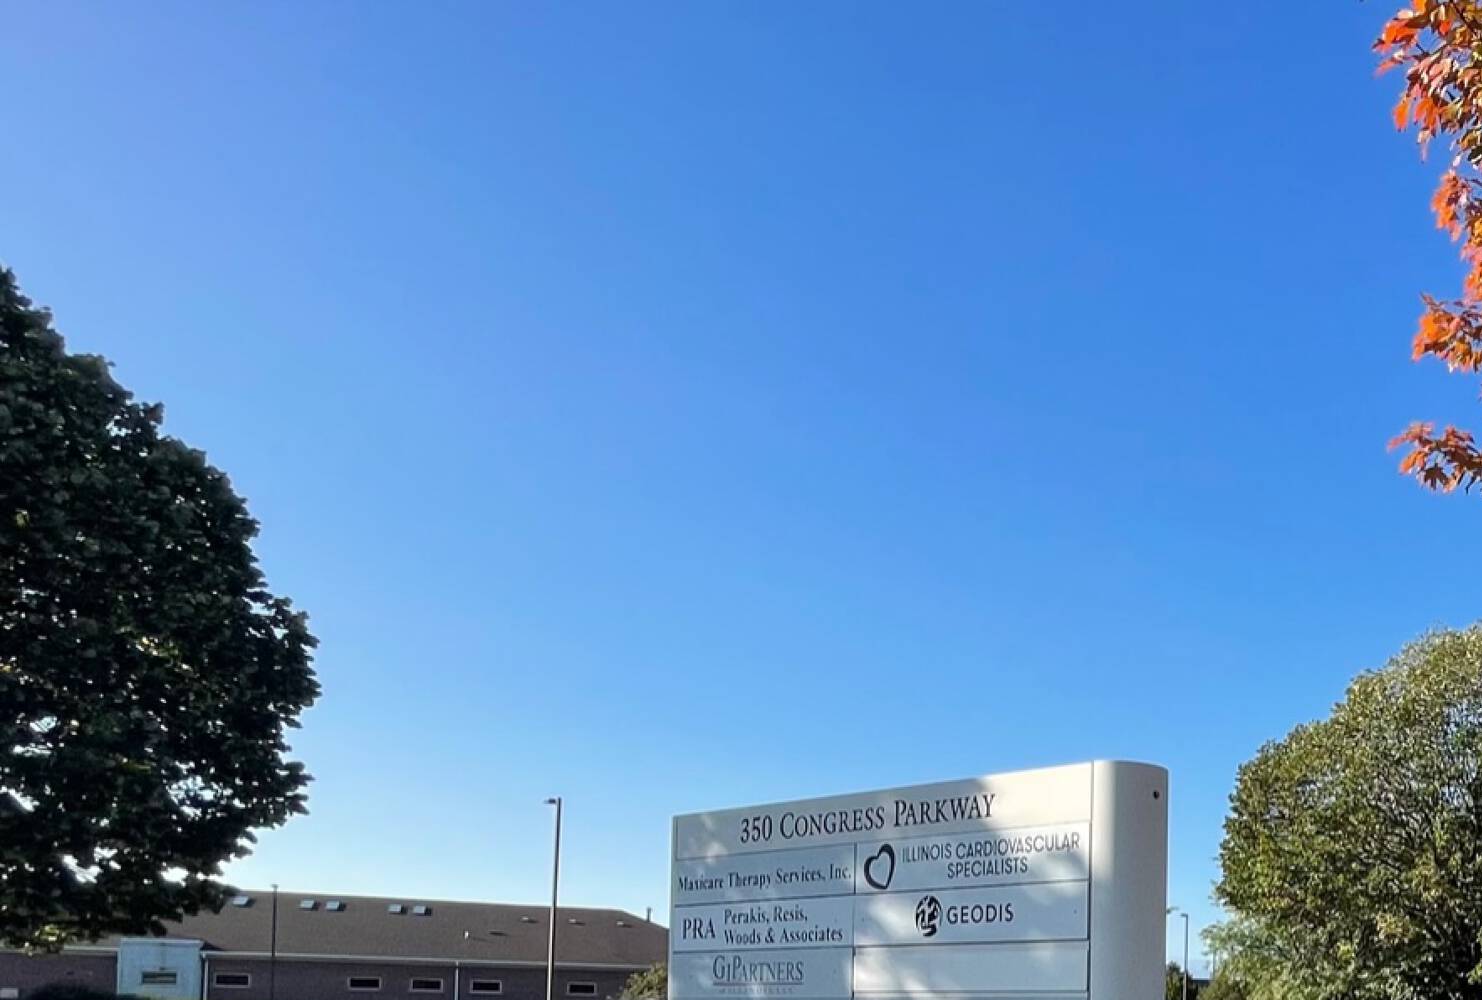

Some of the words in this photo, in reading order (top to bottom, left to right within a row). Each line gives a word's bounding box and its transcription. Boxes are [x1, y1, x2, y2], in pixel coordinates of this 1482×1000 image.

[740, 814, 772, 843] 350
[779, 807, 885, 840] CONGRESS
[894, 793, 996, 828] PARKWAY
[902, 843, 951, 863] ILLINOIS
[956, 832, 1080, 859] CARDIOVASCULAR
[728, 872, 771, 890] Therapy
[776, 865, 826, 884] Services,
[829, 863, 851, 880] Inc.
[947, 857, 1028, 879] SPECIALISTS
[724, 906, 769, 925] Perakis,
[773, 904, 808, 923] Resis,
[947, 903, 1014, 925] GEODIS
[682, 917, 716, 939] PRA
[724, 928, 761, 945] Woods
[765, 927, 775, 943] &
[780, 925, 843, 943] Associates
